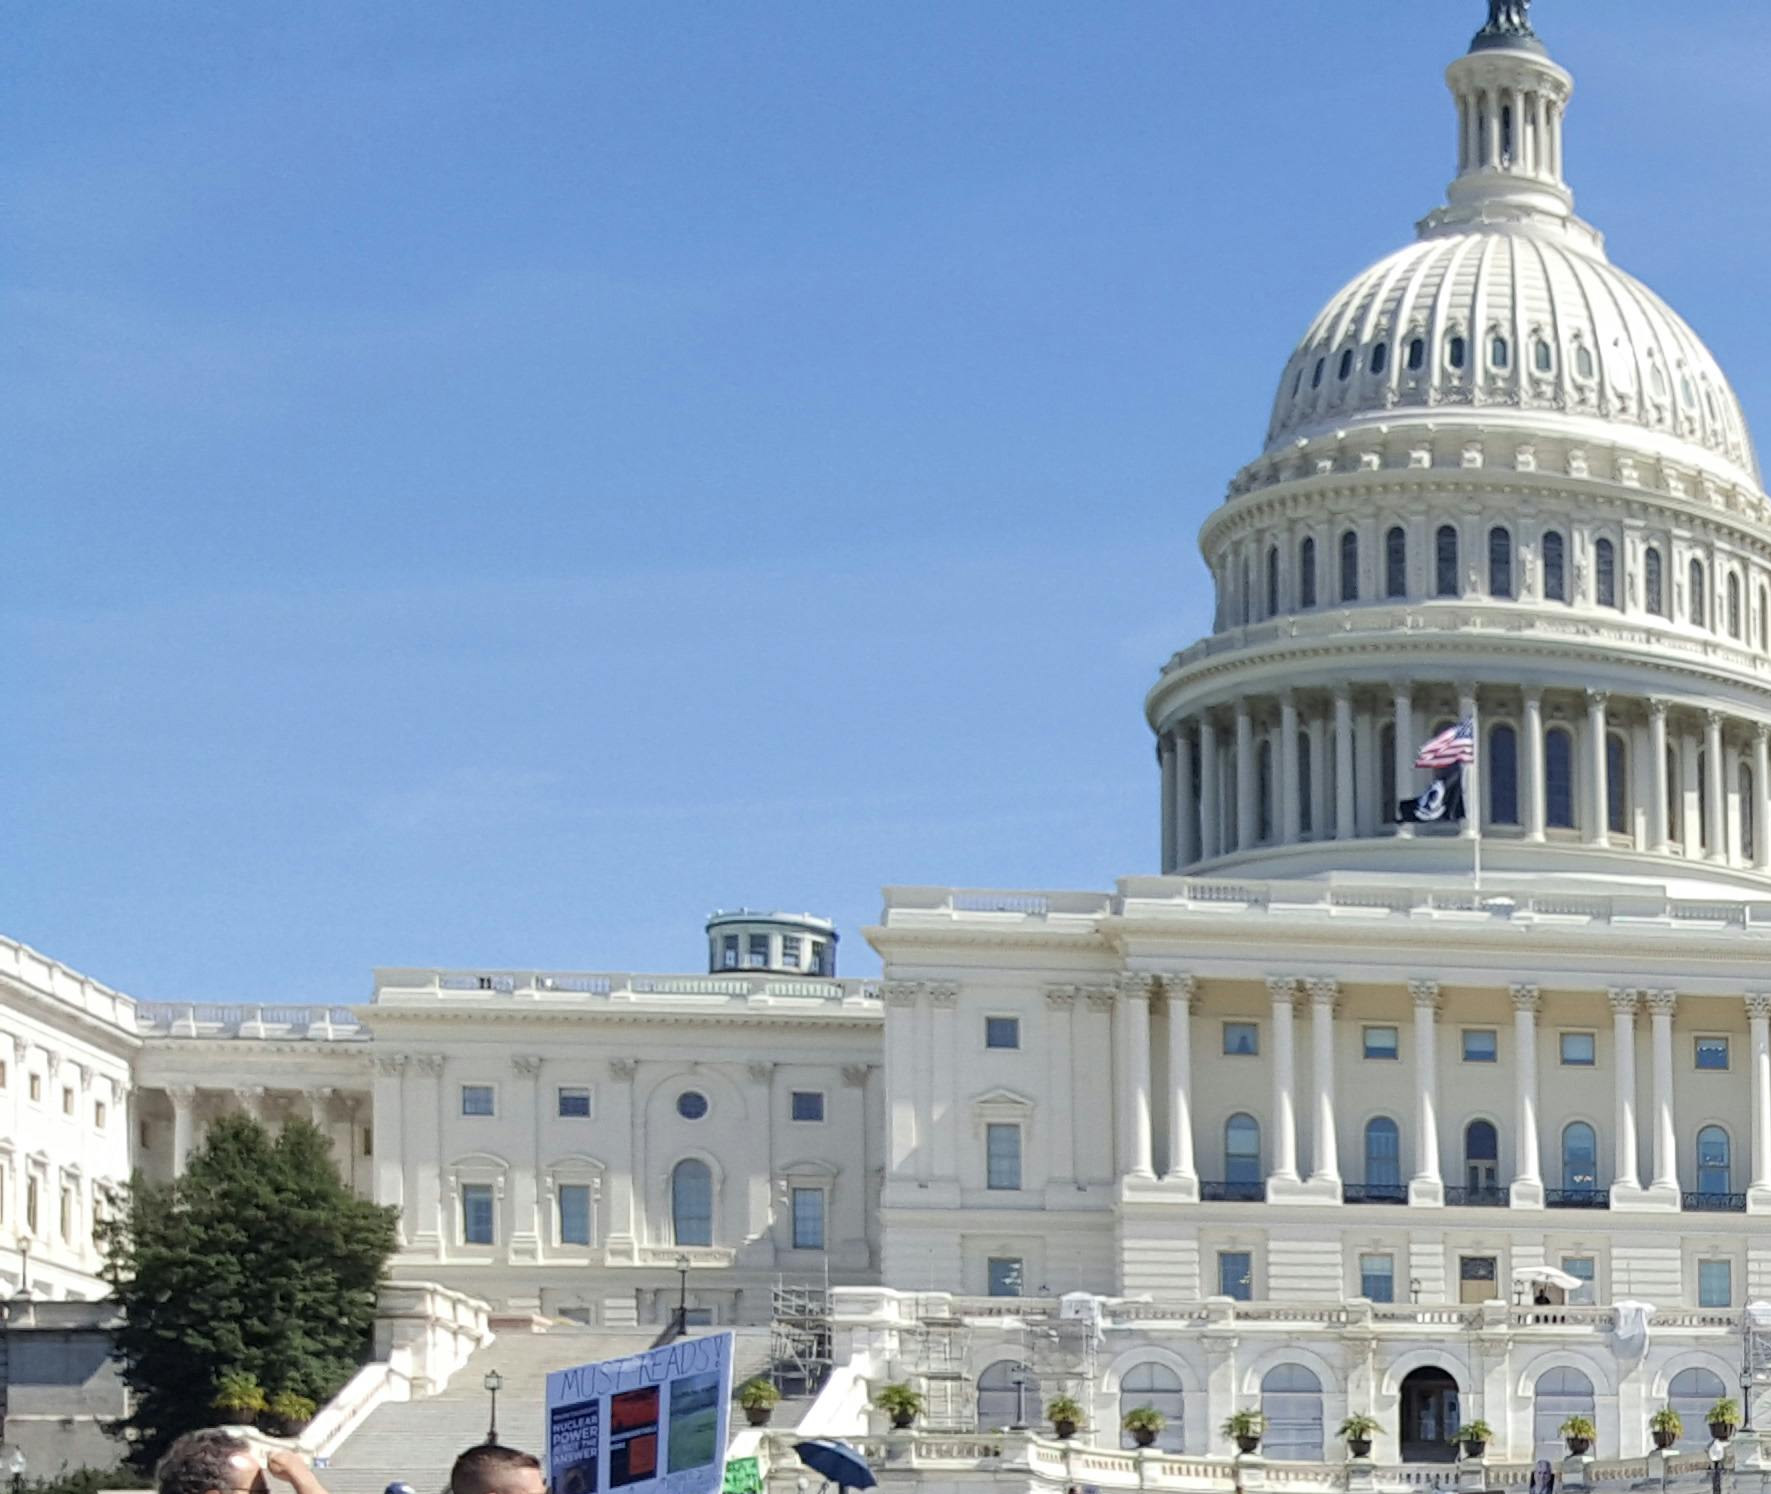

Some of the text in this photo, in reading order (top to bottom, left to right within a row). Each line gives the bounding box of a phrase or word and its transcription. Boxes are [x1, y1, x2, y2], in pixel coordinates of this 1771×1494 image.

[560, 1359, 624, 1400] MUST
[552, 1415, 598, 1433] NUCLEAR
[552, 1425, 598, 1445] POWER
[552, 1447, 598, 1465] ANSWER
